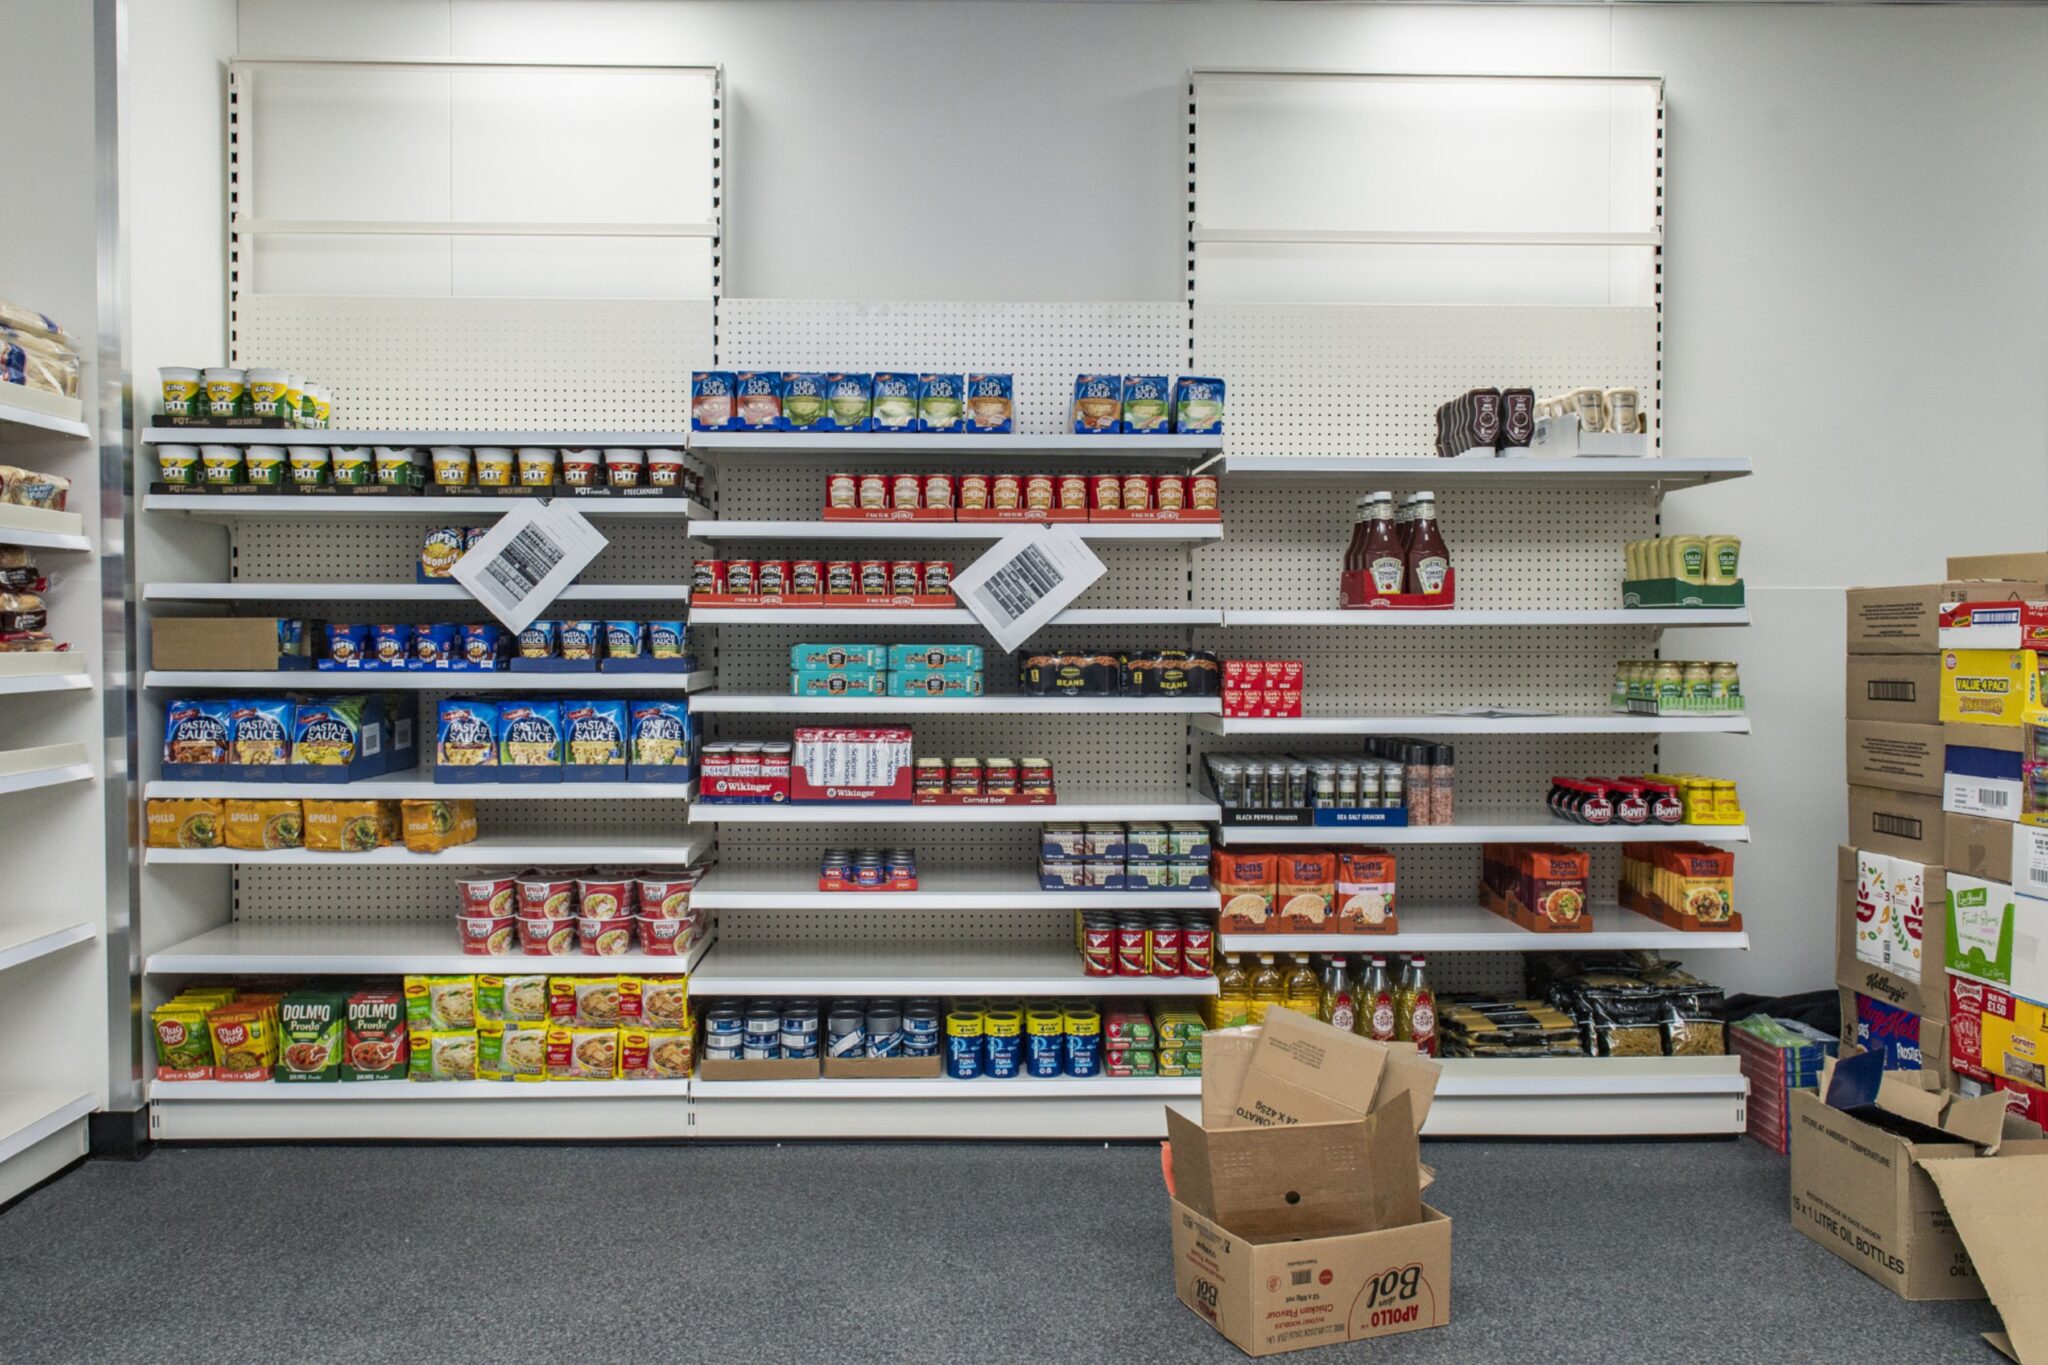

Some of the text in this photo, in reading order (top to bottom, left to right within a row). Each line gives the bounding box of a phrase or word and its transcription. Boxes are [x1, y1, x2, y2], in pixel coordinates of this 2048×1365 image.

[166, 384, 187, 392] KING
[212, 385, 232, 393] KING
[255, 385, 275, 393] KING
[978, 389, 1001, 397] SOUP
[1087, 390, 1110, 398] SOUP
[1135, 392, 1158, 400] SOUP
[1188, 392, 1211, 400] SOUP
[166, 401, 190, 412] POT
[211, 401, 235, 412] POT
[254, 402, 278, 412] POT
[163, 468, 188, 478] POT
[208, 468, 233, 478] POT
[295, 469, 320, 479] POT
[440, 469, 466, 480] POT
[480, 469, 503, 480] POT
[523, 469, 546, 480] POT
[566, 470, 588, 481] POT
[614, 470, 639, 481] POT
[653, 470, 677, 481] POT
[425, 531, 457, 547] SUPER
[1056, 679, 1084, 688] BEANS
[1160, 680, 1188, 689] BEANS
[1956, 678, 2009, 693] VALUE 4 PACK
[180, 721, 210, 731] PASTA
[239, 720, 268, 731] PASTA
[309, 723, 338, 735] PASTA
[513, 722, 541, 732] PASTA
[576, 721, 605, 732] PASTA
[642, 721, 671, 731] PASTA
[178, 729, 220, 741] SAUCE
[238, 730, 280, 741] SAUCE
[307, 731, 349, 743] SAUCE
[512, 732, 552, 742] SAUCE
[574, 732, 616, 742] SAUCE
[641, 731, 681, 741] SAUCE
[728, 782, 772, 792] Wikinger
[837, 790, 876, 798] Wikinger
[1584, 803, 1612, 817] Bovril
[1620, 803, 1647, 817] Bovril
[1655, 802, 1682, 816] Bovril
[231, 813, 260, 823] APOLLO
[308, 813, 337, 824] APOLLO
[1235, 861, 1263, 872] Ben's
[1294, 861, 1322, 872] Ben's
[1353, 861, 1382, 871] Ben's
[1550, 859, 1577, 870] Ben's
[1690, 858, 1719, 869] Ben's
[1862, 862, 1867, 872] 2
[1915, 875, 1920, 886] 2
[1884, 892, 1890, 902] 3
[1891, 895, 1895, 905] 1
[1866, 973, 1908, 1003] Kellogg's
[1987, 1001, 2007, 1016] £1.50
[291, 1020, 321, 1031] Pronto
[358, 1020, 387, 1030] Pronto
[2011, 1034, 2036, 1050] Soreen
[1896, 1042, 1922, 1065] FROSTIES
[1236, 1107, 1275, 1127] OMATO
[1255, 1100, 1298, 1125] 24 X 425g
[1802, 1115, 1891, 1168] STORE AT AMBIENT TEMPERATURE
[1824, 1202, 1841, 1216] STOCK
[1848, 1216, 1860, 1230] DATE
[1861, 1225, 1882, 1241] ORDER
[1792, 1195, 1905, 1275] 15 x 1 LITRE OIL BOTTLES
[1954, 1252, 1967, 1264] 15
[1950, 1265, 1969, 1277] OIL
[1367, 1266, 1421, 1308] Bol
[1197, 1280, 1218, 1307] Bol
[1266, 1303, 1334, 1319] Chicken Flavour
[1372, 1304, 1419, 1328] APOLLO
[1275, 1316, 1325, 1329] INSTANT NOODLES
